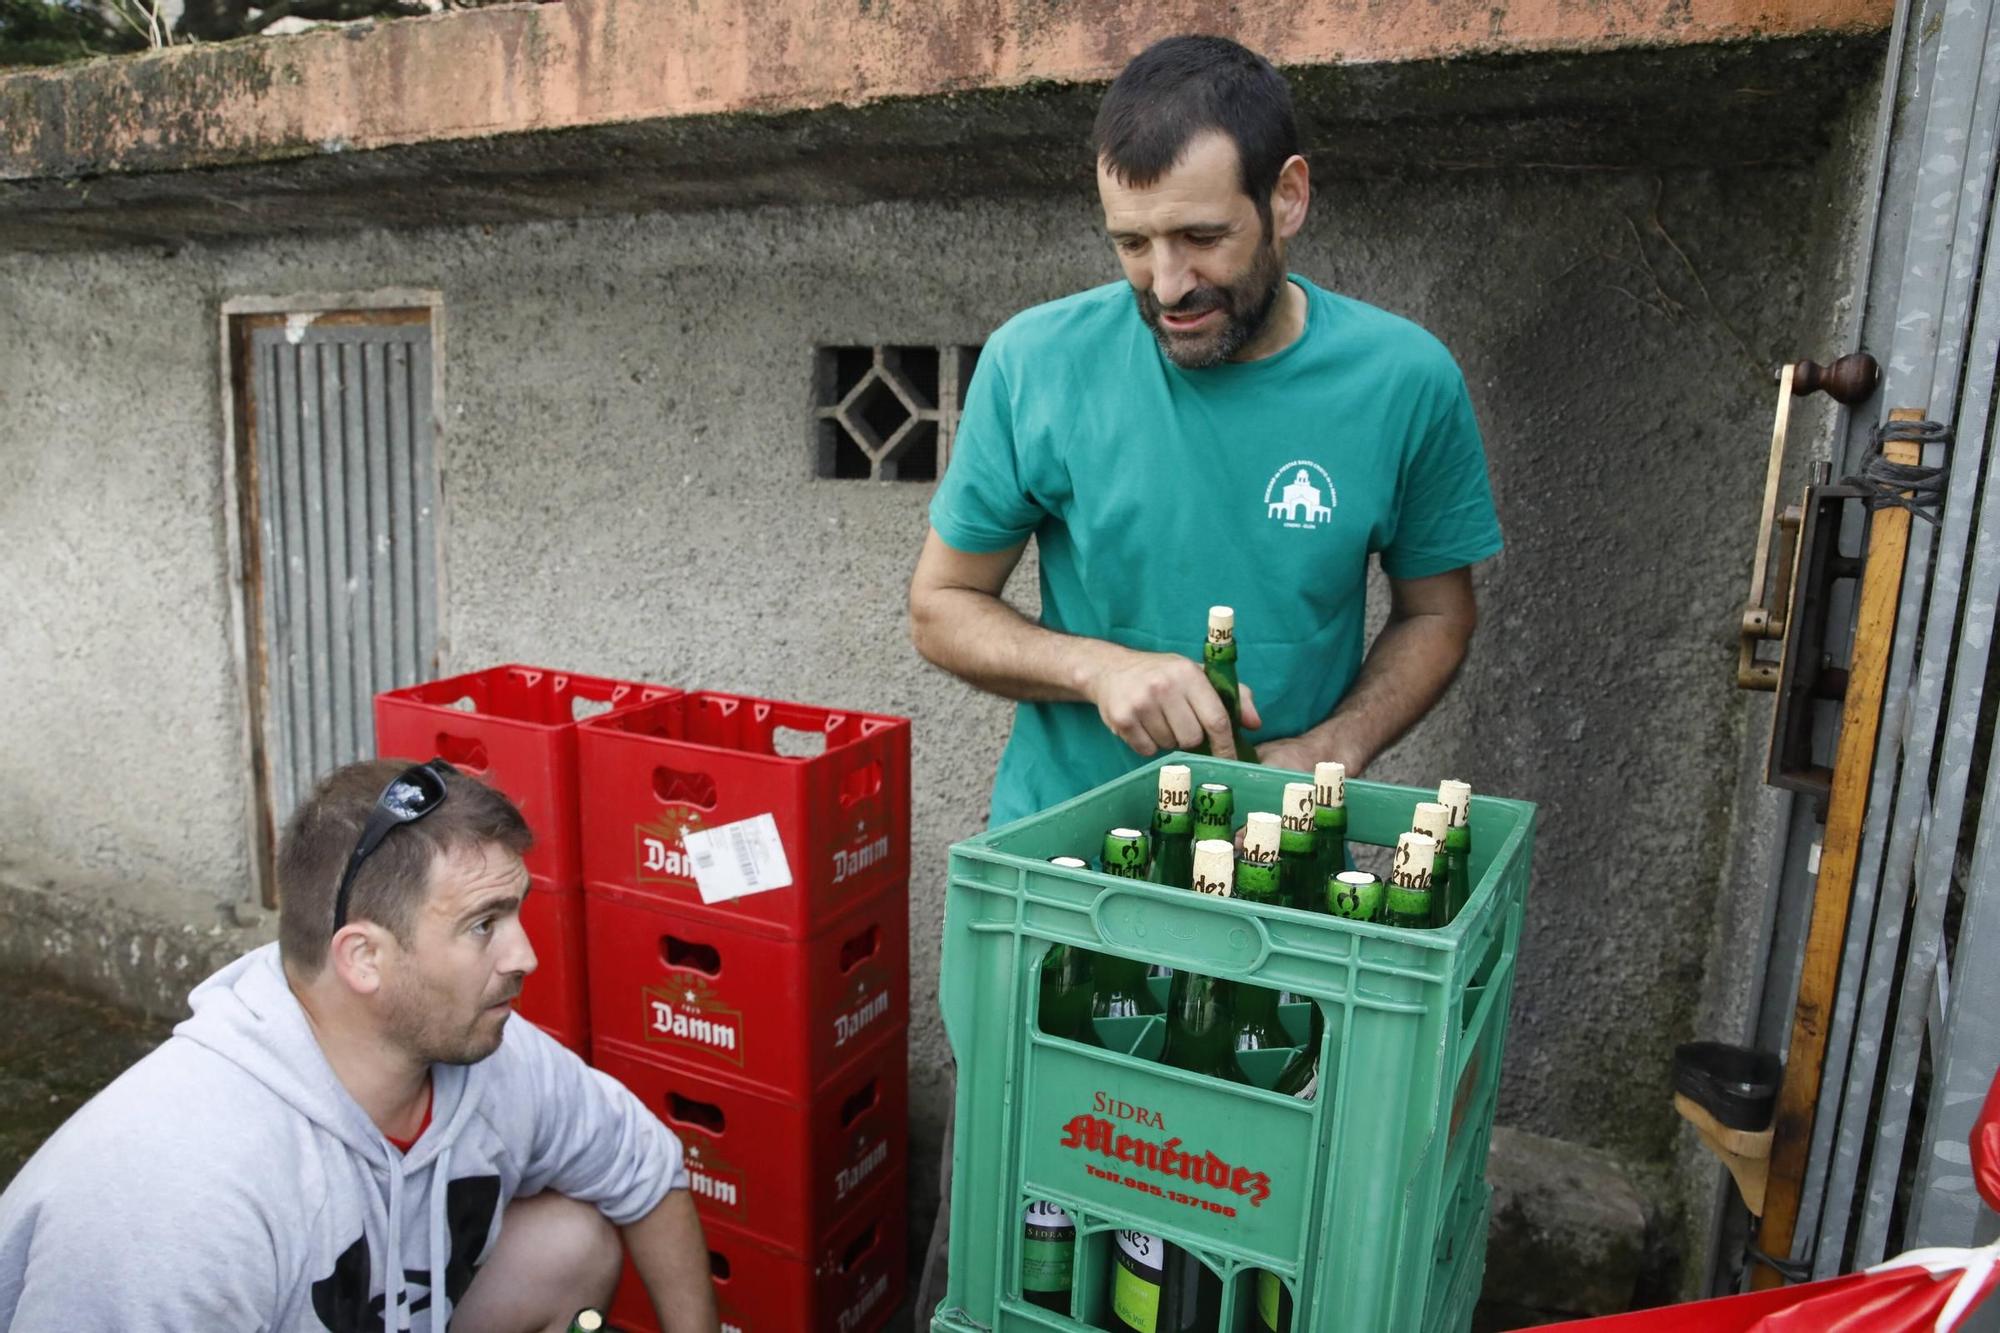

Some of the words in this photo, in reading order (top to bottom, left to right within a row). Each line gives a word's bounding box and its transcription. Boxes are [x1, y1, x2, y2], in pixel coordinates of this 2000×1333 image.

[832, 835, 888, 884] Damm
[651, 1000, 735, 1051] Damm
[834, 989, 888, 1048] Damm
[1092, 1090, 1166, 1131] SIDRA
[1060, 1114, 1271, 1207] Menéndez
